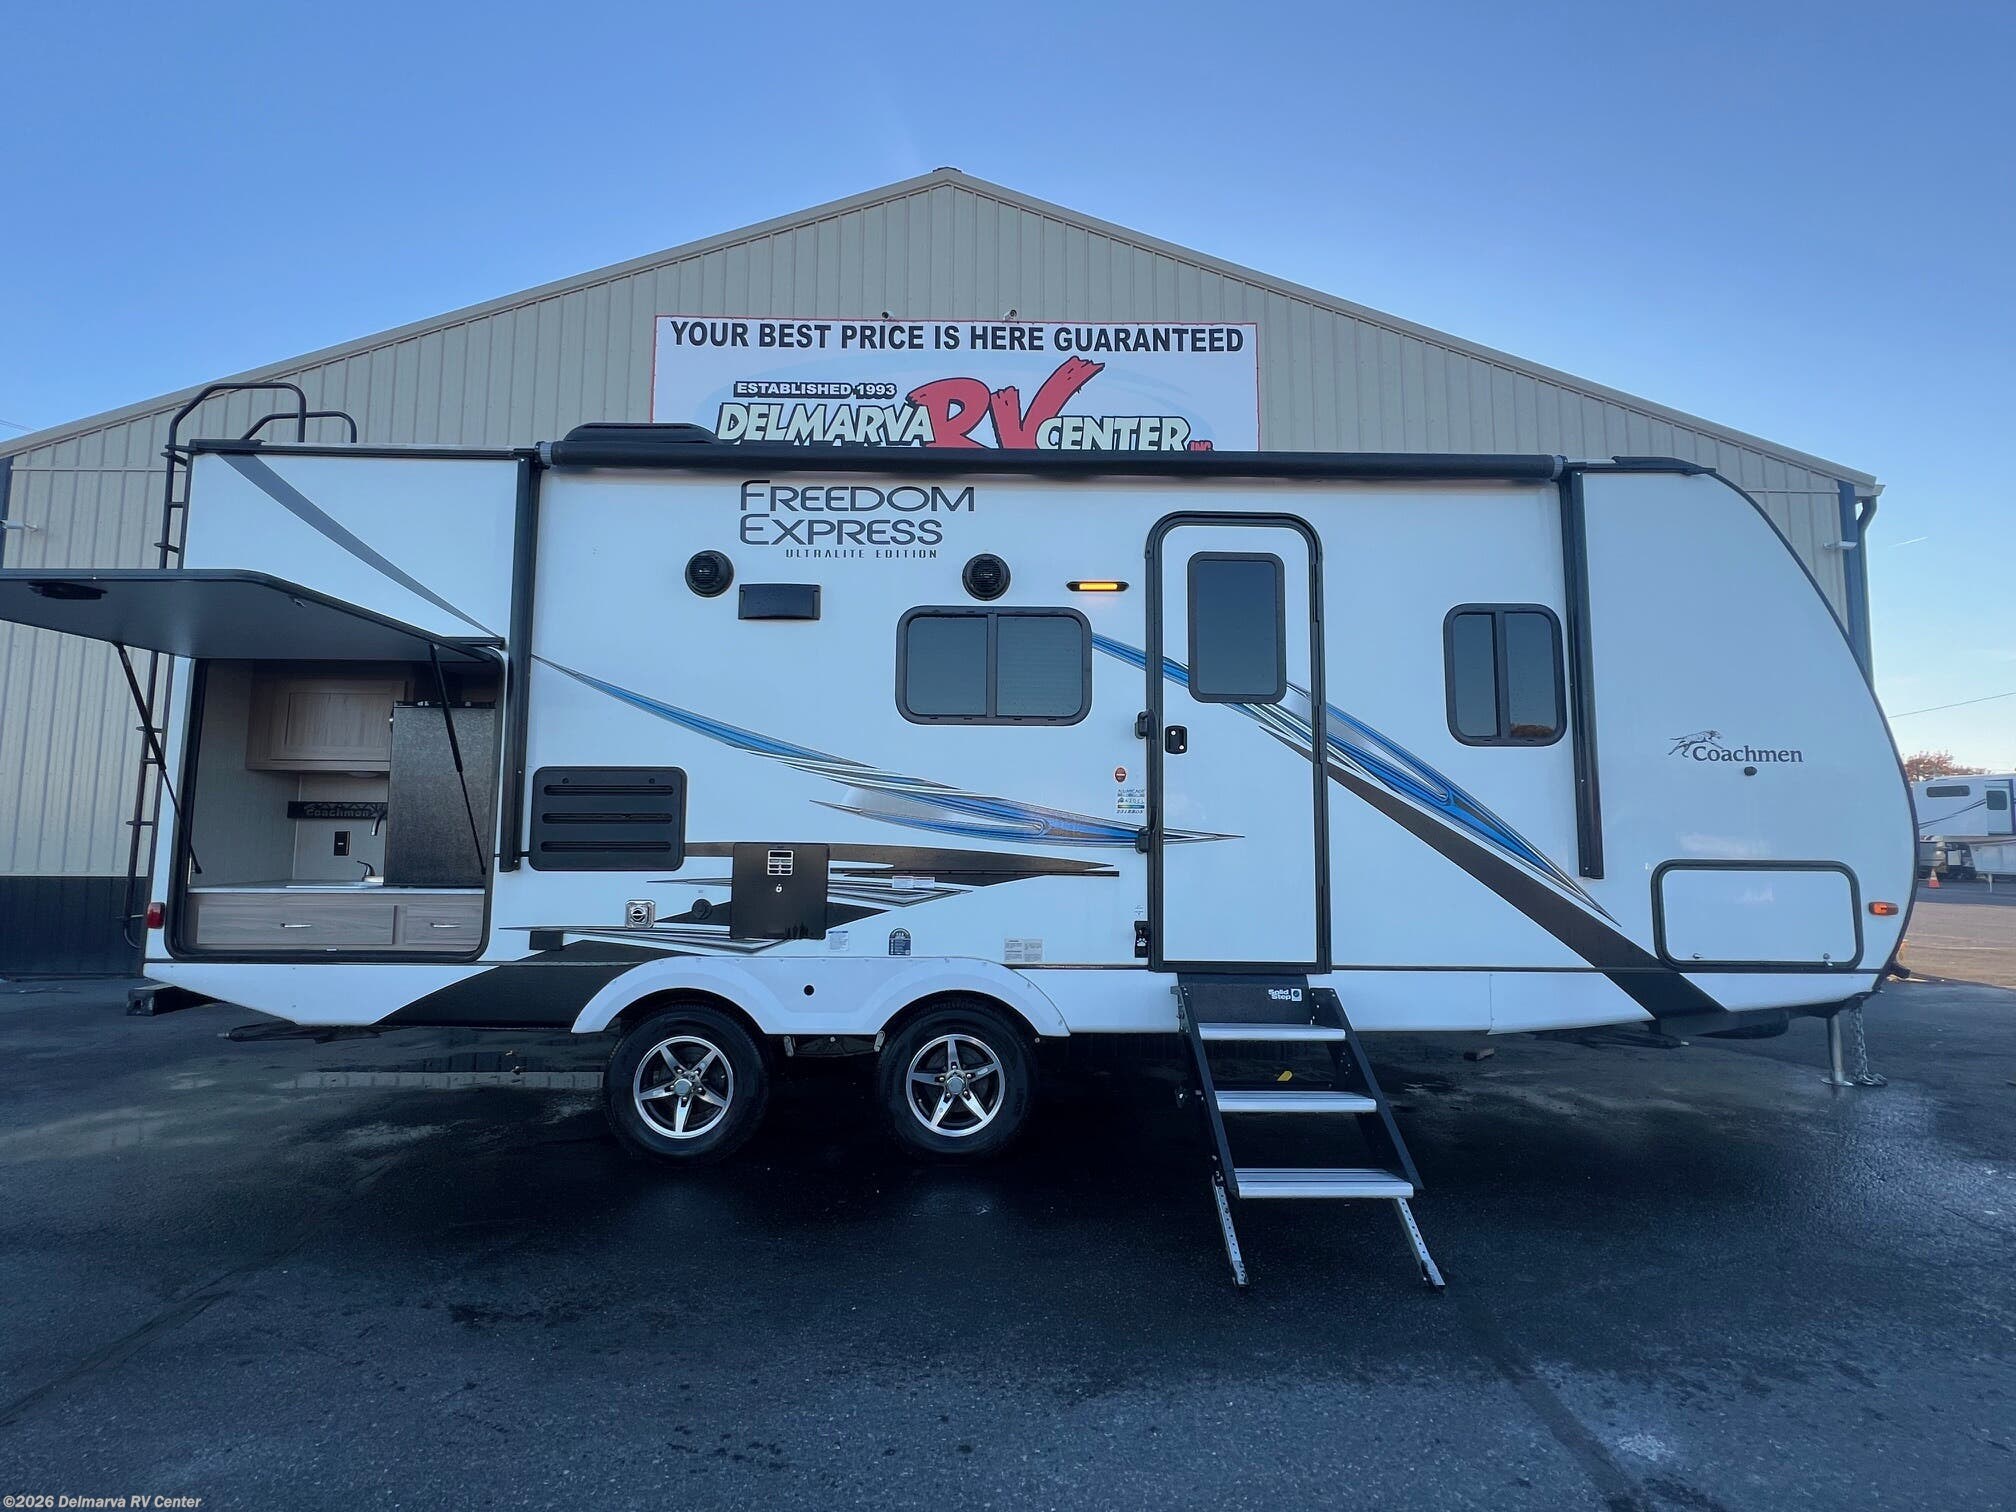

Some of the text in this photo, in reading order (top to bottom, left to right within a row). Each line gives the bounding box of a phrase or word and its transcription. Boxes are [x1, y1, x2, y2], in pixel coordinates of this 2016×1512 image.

[671, 320, 1244, 353] YOUR BEST PRICE IS HERE GUARANTEED
[716, 402, 937, 446] DELMARVA
[905, 355, 1105, 449] RV
[1036, 416, 1191, 450] CENTER
[737, 382, 897, 396] ESTABLISHED 1993
[740, 479, 975, 512] FREEDOM
[739, 513, 943, 546] EXPRESS
[786, 549, 938, 559] ULTRALITE EDITION
[1692, 744, 1804, 763] Coachmen
